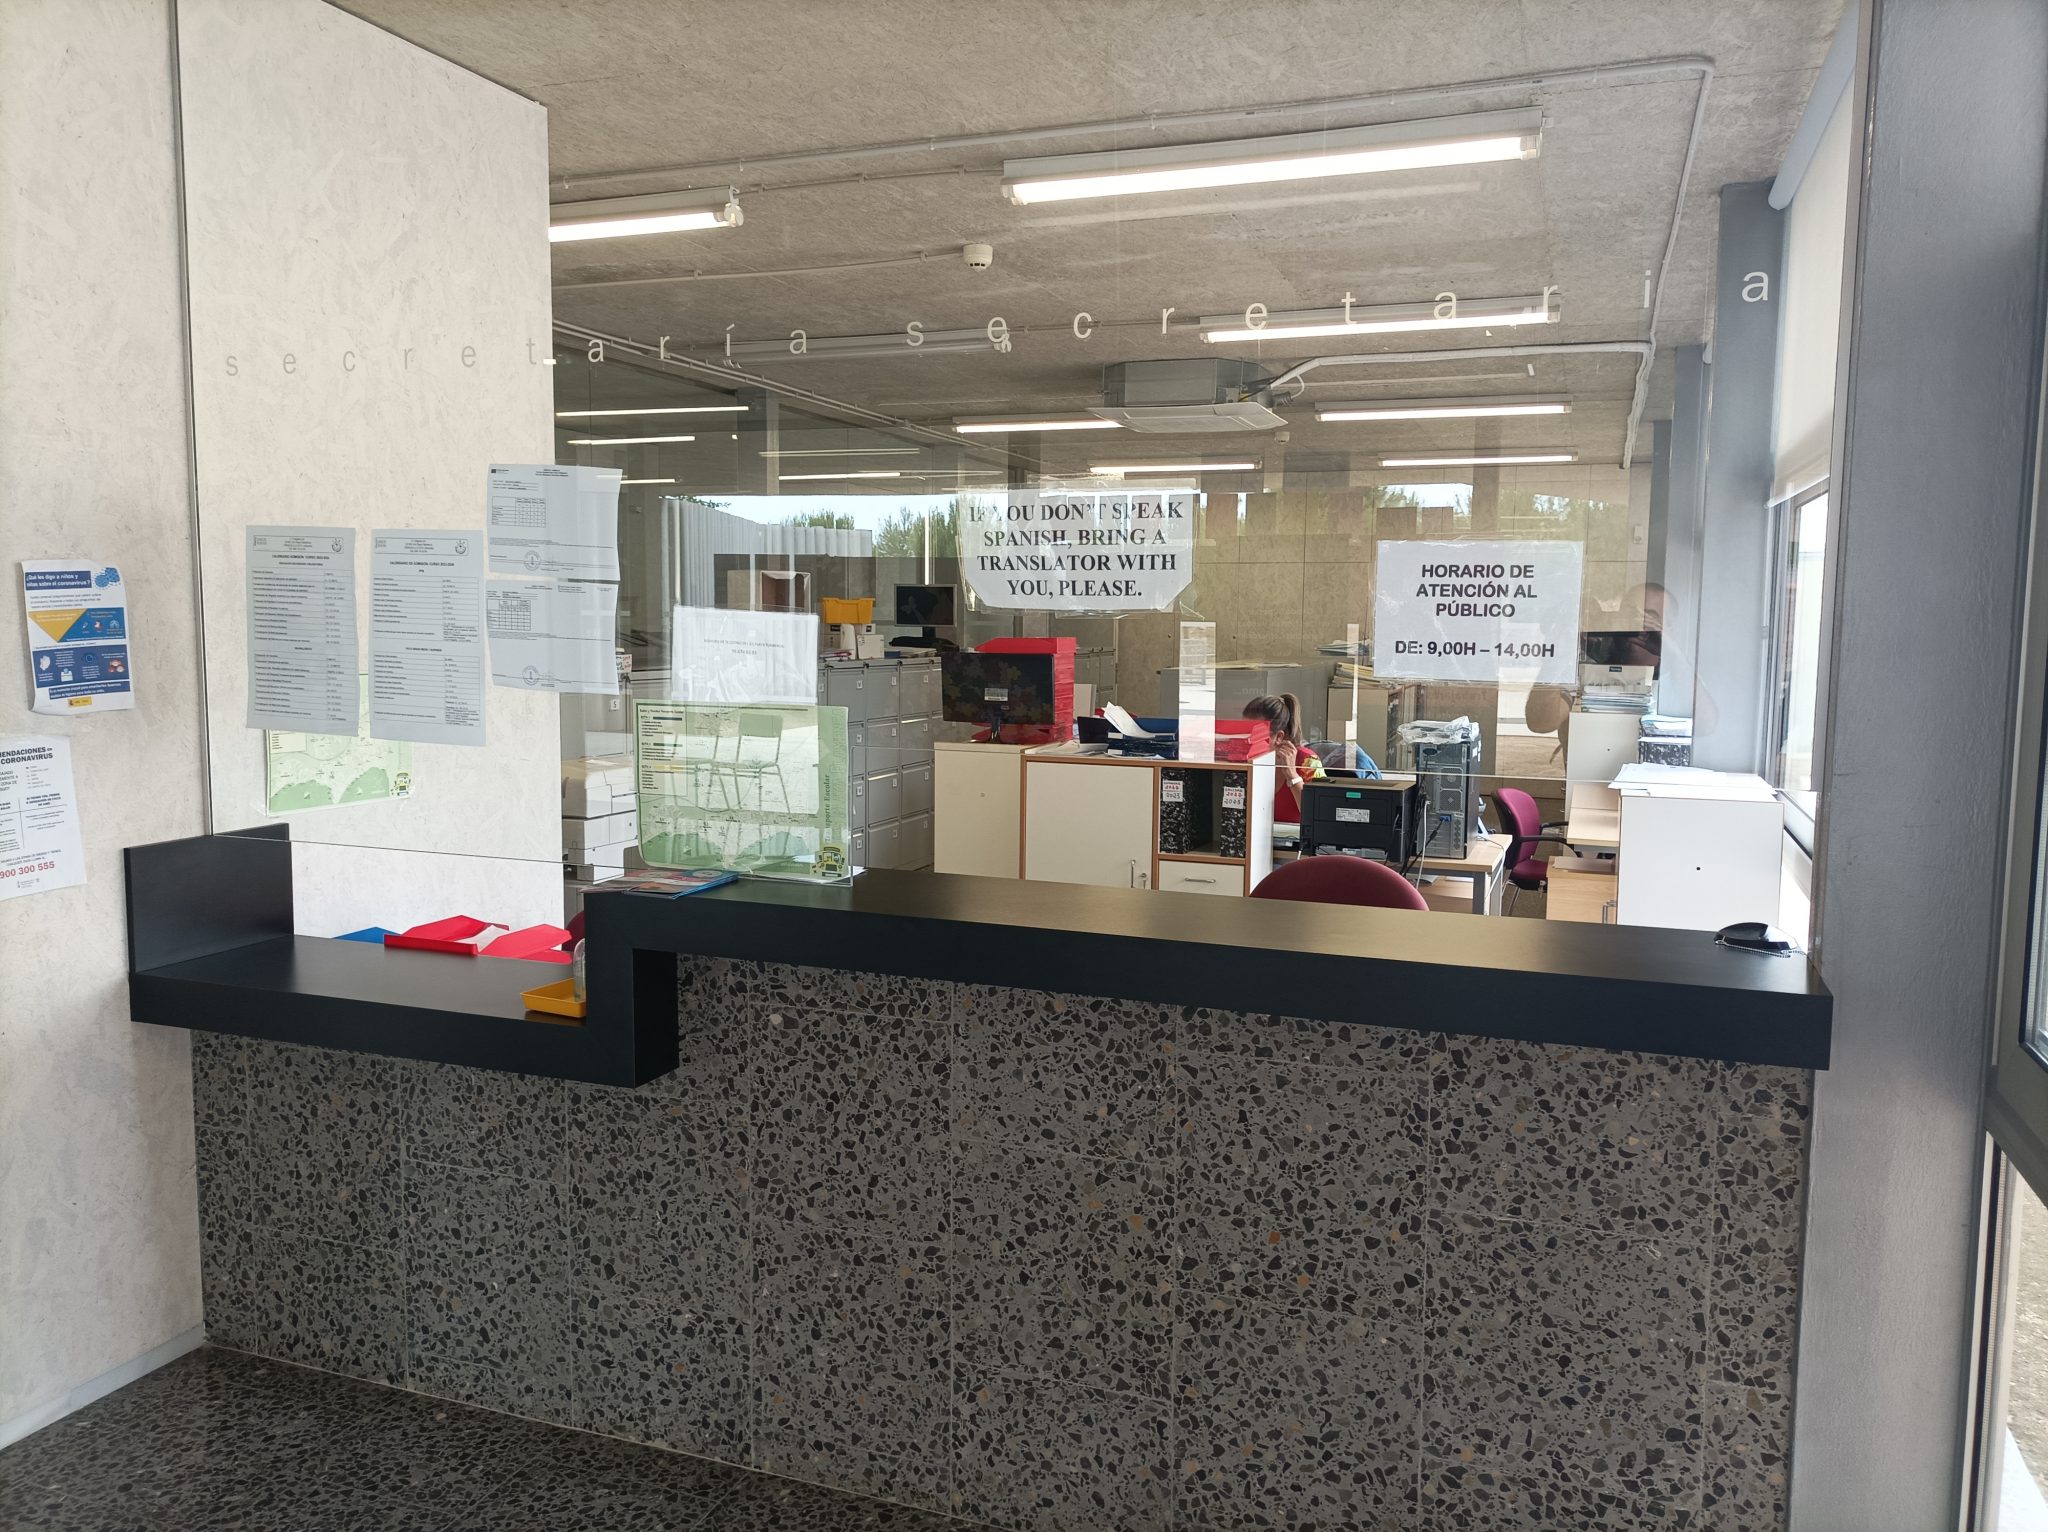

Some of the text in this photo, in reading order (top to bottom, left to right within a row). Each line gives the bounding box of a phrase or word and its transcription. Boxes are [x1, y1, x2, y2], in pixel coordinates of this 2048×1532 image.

[1112, 501, 1184, 520] SPEAK
[984, 528, 1167, 549] SPANISH, BRING A
[977, 553, 1177, 571] TRANSLATOR WITH
[1421, 564, 1535, 578] HORARIO DE
[1006, 579, 1142, 599] YOU, PLEASE.
[1416, 581, 1538, 598] ATENCIÓN AL
[1436, 600, 1516, 618] PÚBLICO
[1395, 640, 1423, 655] DE:
[1427, 641, 1476, 658] 9,00H
[1494, 642, 1555, 659] 14,00H
[0, 746, 46, 758] ENDACIONES
[1, 752, 53, 764] CORONAVIRUS
[0, 861, 55, 879] 900 300 555
